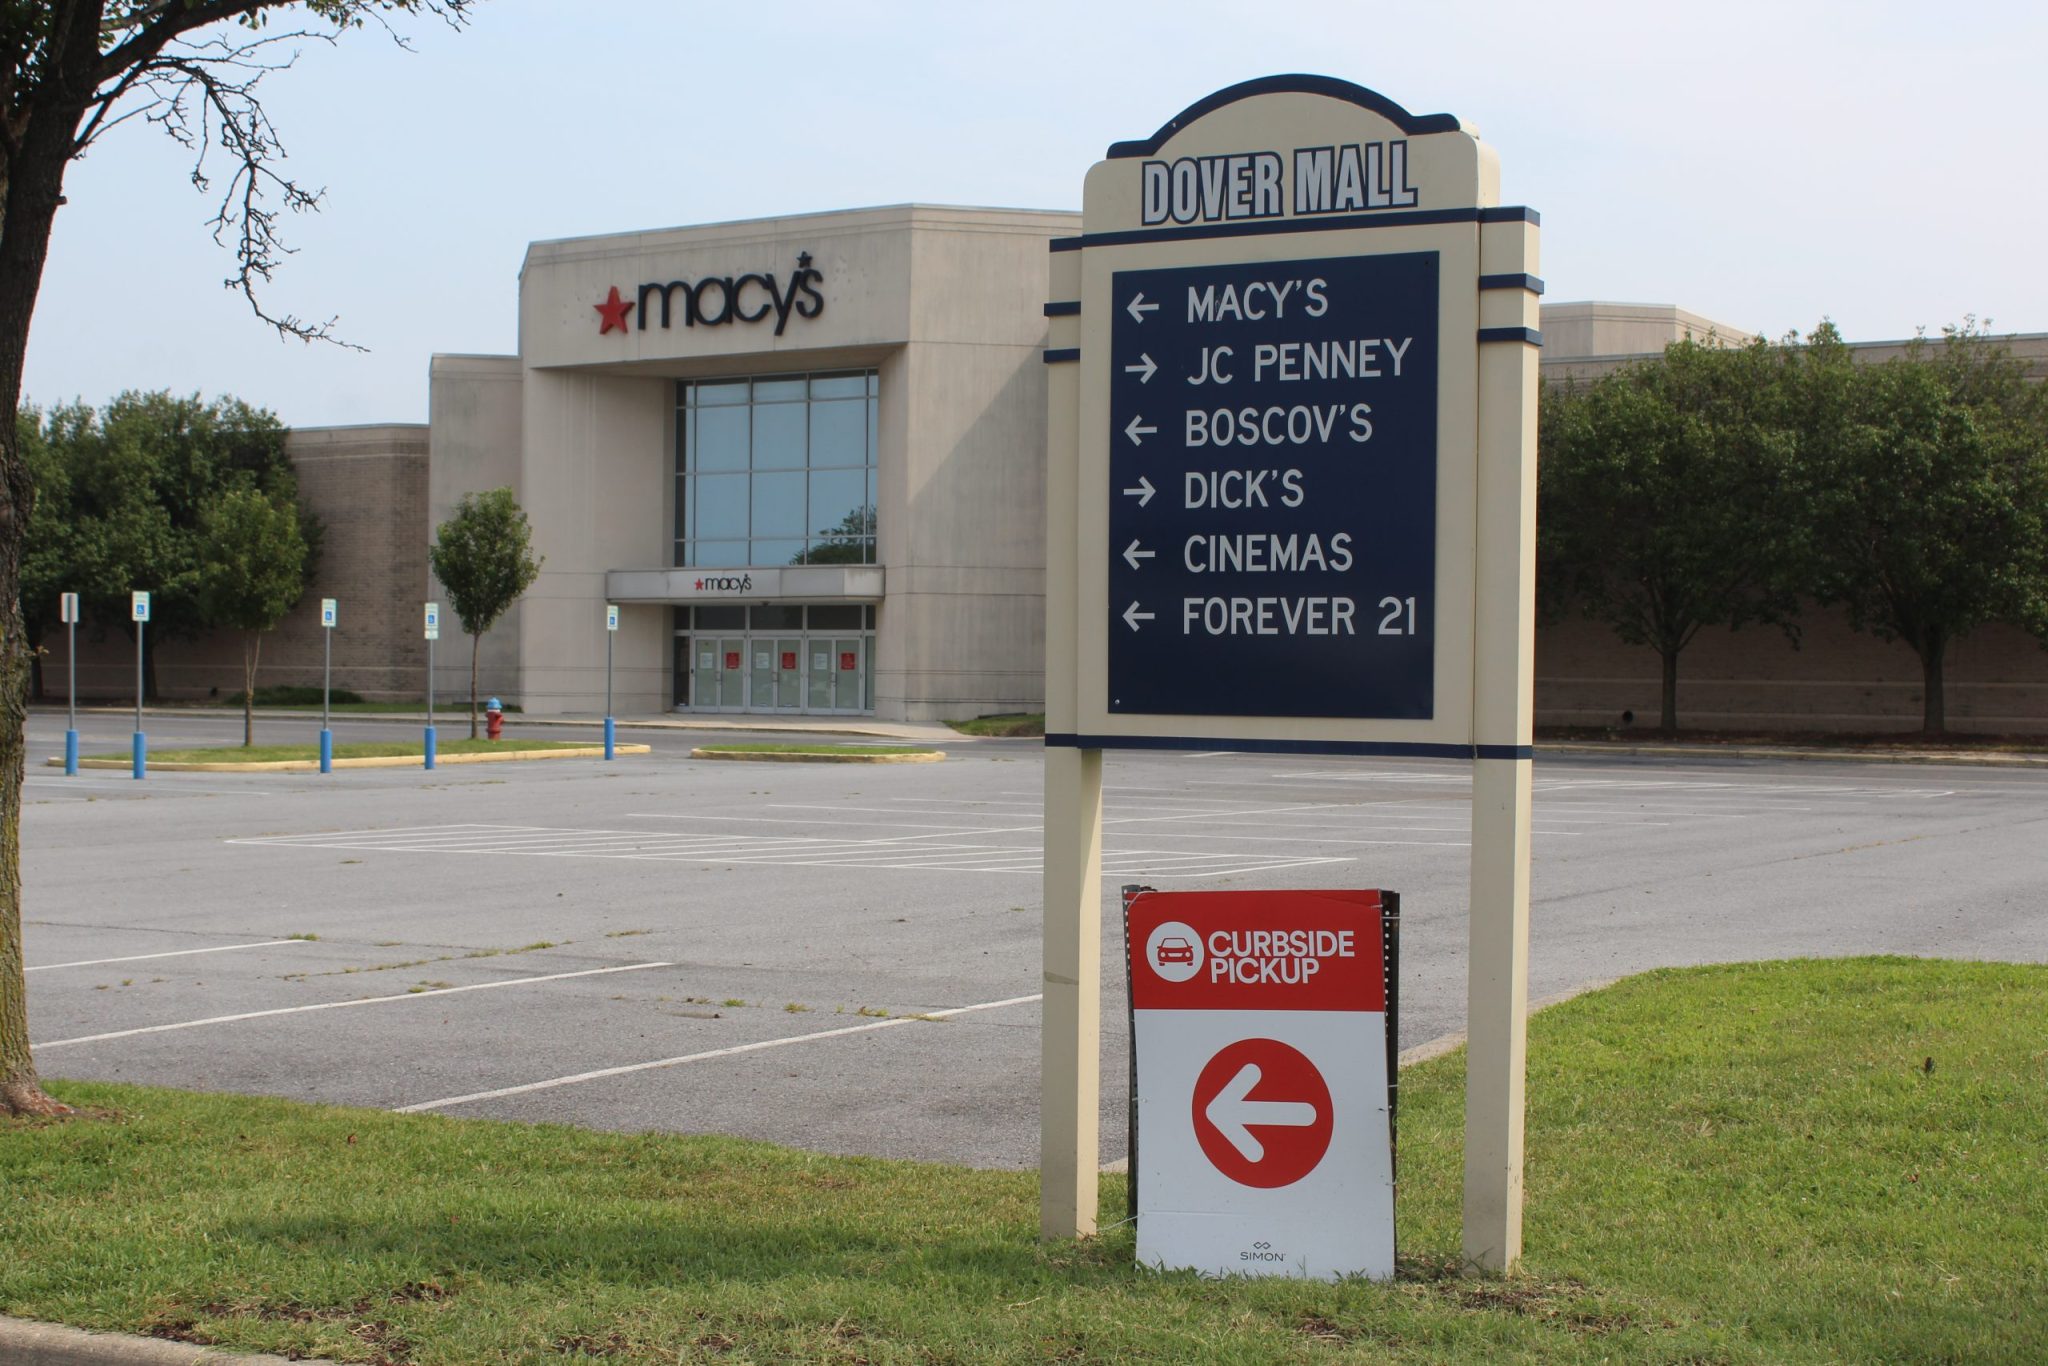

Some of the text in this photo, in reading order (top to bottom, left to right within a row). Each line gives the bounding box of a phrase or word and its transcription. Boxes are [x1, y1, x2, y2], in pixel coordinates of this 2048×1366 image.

[1142, 139, 1418, 226] DOVER MALL
[638, 251, 824, 336] macy's
[1187, 278, 1329, 323] MACY'S
[1187, 337, 1413, 385] JC PENNEY
[1185, 403, 1373, 447] BOSCOV'S
[1185, 468, 1304, 509] DICK'S
[1184, 532, 1353, 573] CINEMAS
[705, 573, 752, 594] macy's
[1183, 596, 1416, 635] FOREVER 21
[1208, 930, 1355, 957] CURBSIDE
[1210, 957, 1320, 984] PICKUP
[1240, 1251, 1284, 1262] SIMON
